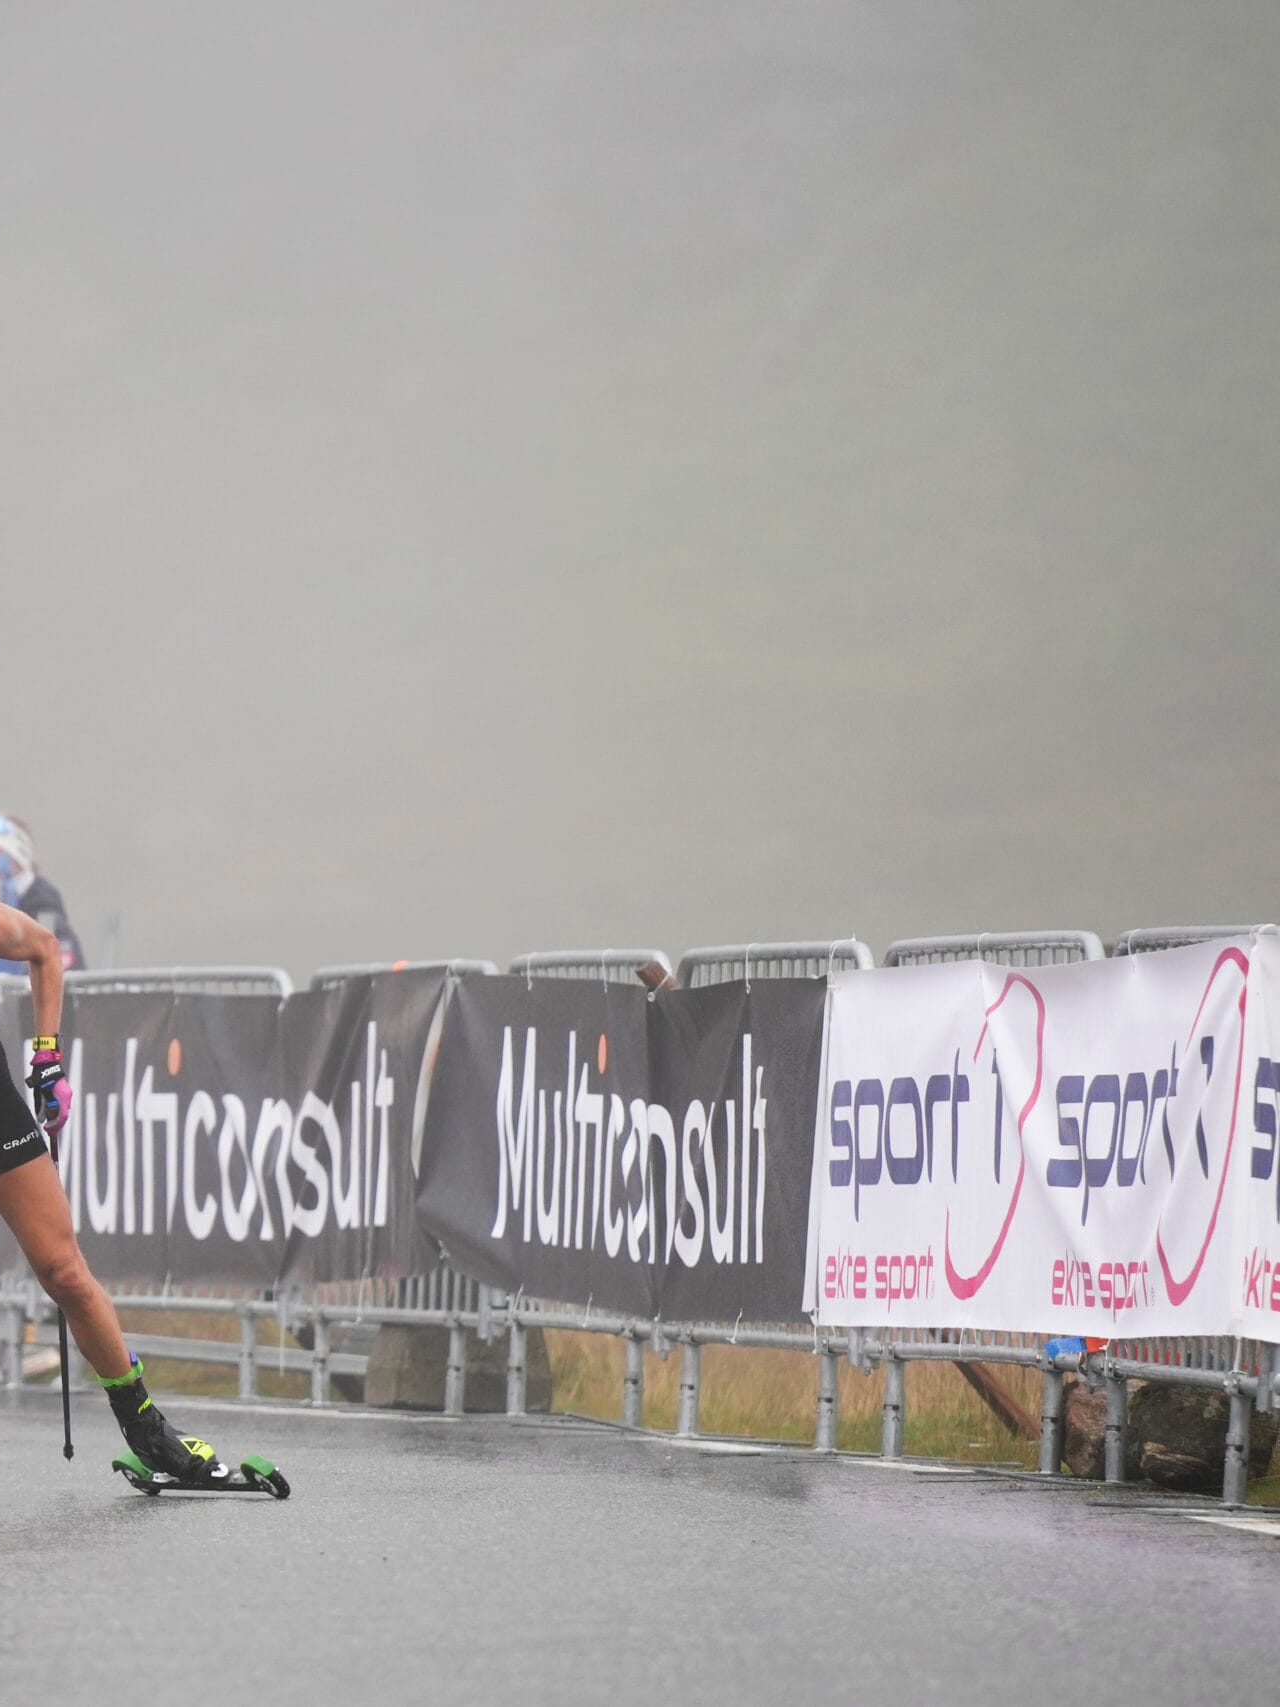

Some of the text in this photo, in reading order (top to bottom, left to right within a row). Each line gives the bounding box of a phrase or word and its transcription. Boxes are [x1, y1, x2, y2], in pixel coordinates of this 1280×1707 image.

[3, 1130, 38, 1150] CRAFT
[23, 1021, 394, 1241] Multiconsult
[491, 1026, 767, 1268] Multiconsult
[829, 1047, 970, 1222] sport
[1046, 1040, 1179, 1227] sport
[875, 1245, 933, 1314] sport
[1098, 1259, 1149, 1324] sport
